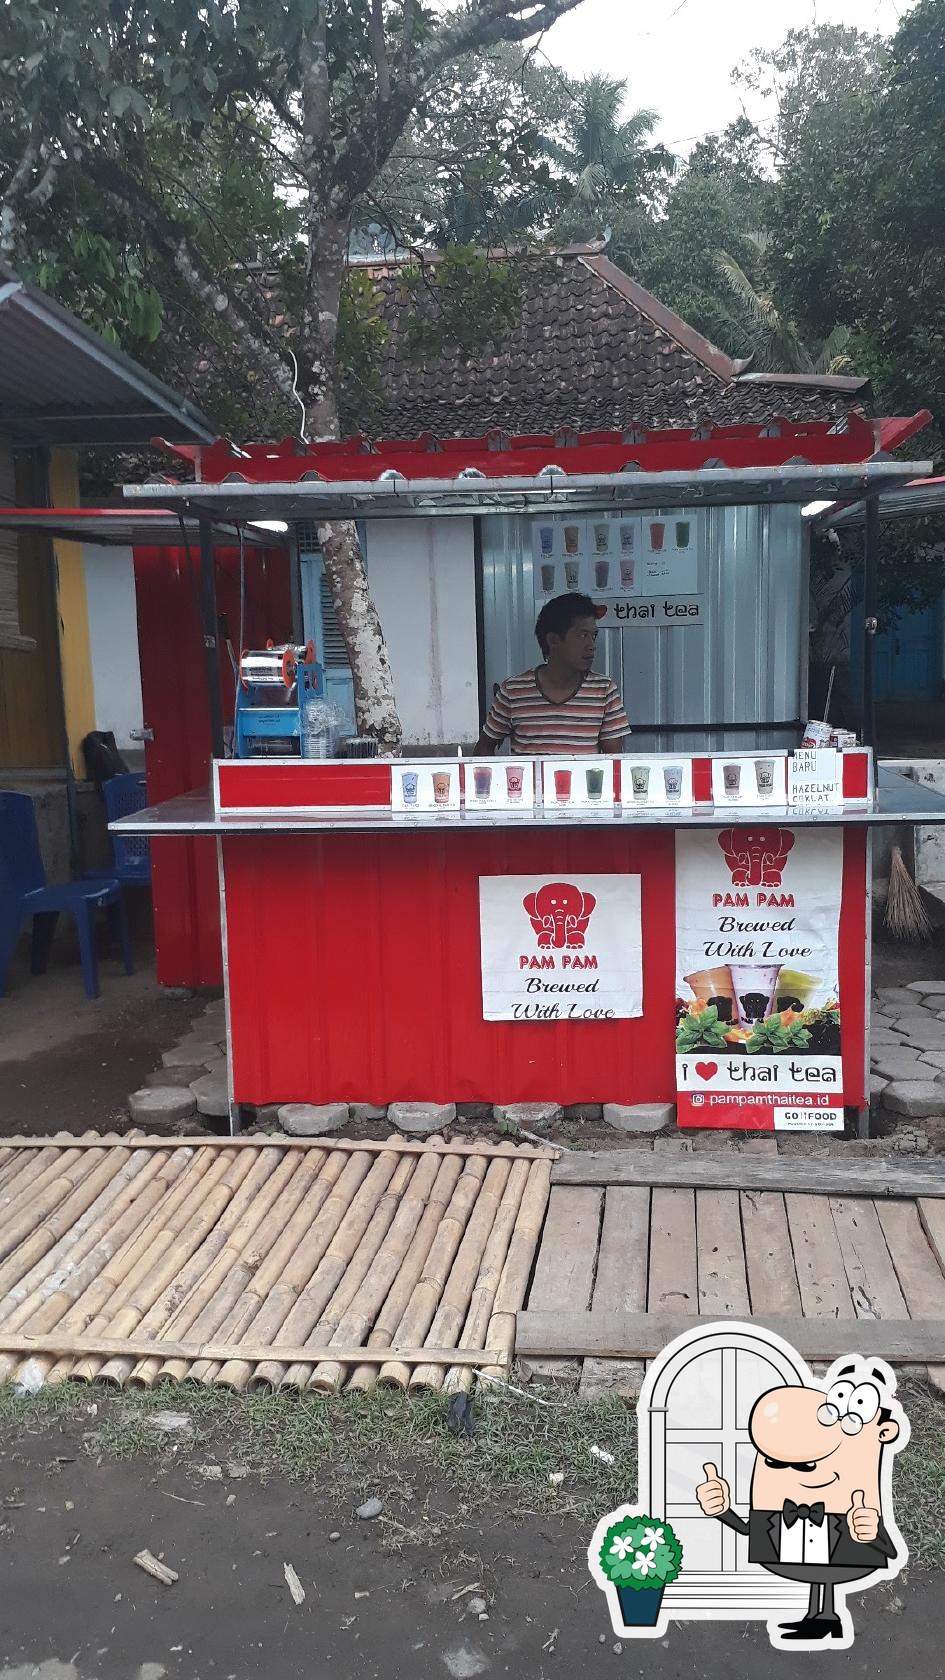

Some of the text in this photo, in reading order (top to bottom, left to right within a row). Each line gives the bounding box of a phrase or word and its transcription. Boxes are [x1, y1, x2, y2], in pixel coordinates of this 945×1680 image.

[614, 601, 699, 619] thai tea
[792, 761, 816, 773] BARU
[792, 783, 840, 794] HAZELNUT
[712, 893, 795, 907] PAM PAM
[718, 916, 796, 932] Brewed
[703, 941, 812, 957] With Love
[519, 955, 598, 969] PAM PAM
[525, 977, 599, 993] Brewed
[512, 1003, 615, 1018] With Love
[726, 1061, 779, 1082] thai
[788, 1061, 837, 1083] tea
[710, 1094, 830, 1107] pampamthaitea.id
[784, 1112, 837, 1121] GO FOOD
